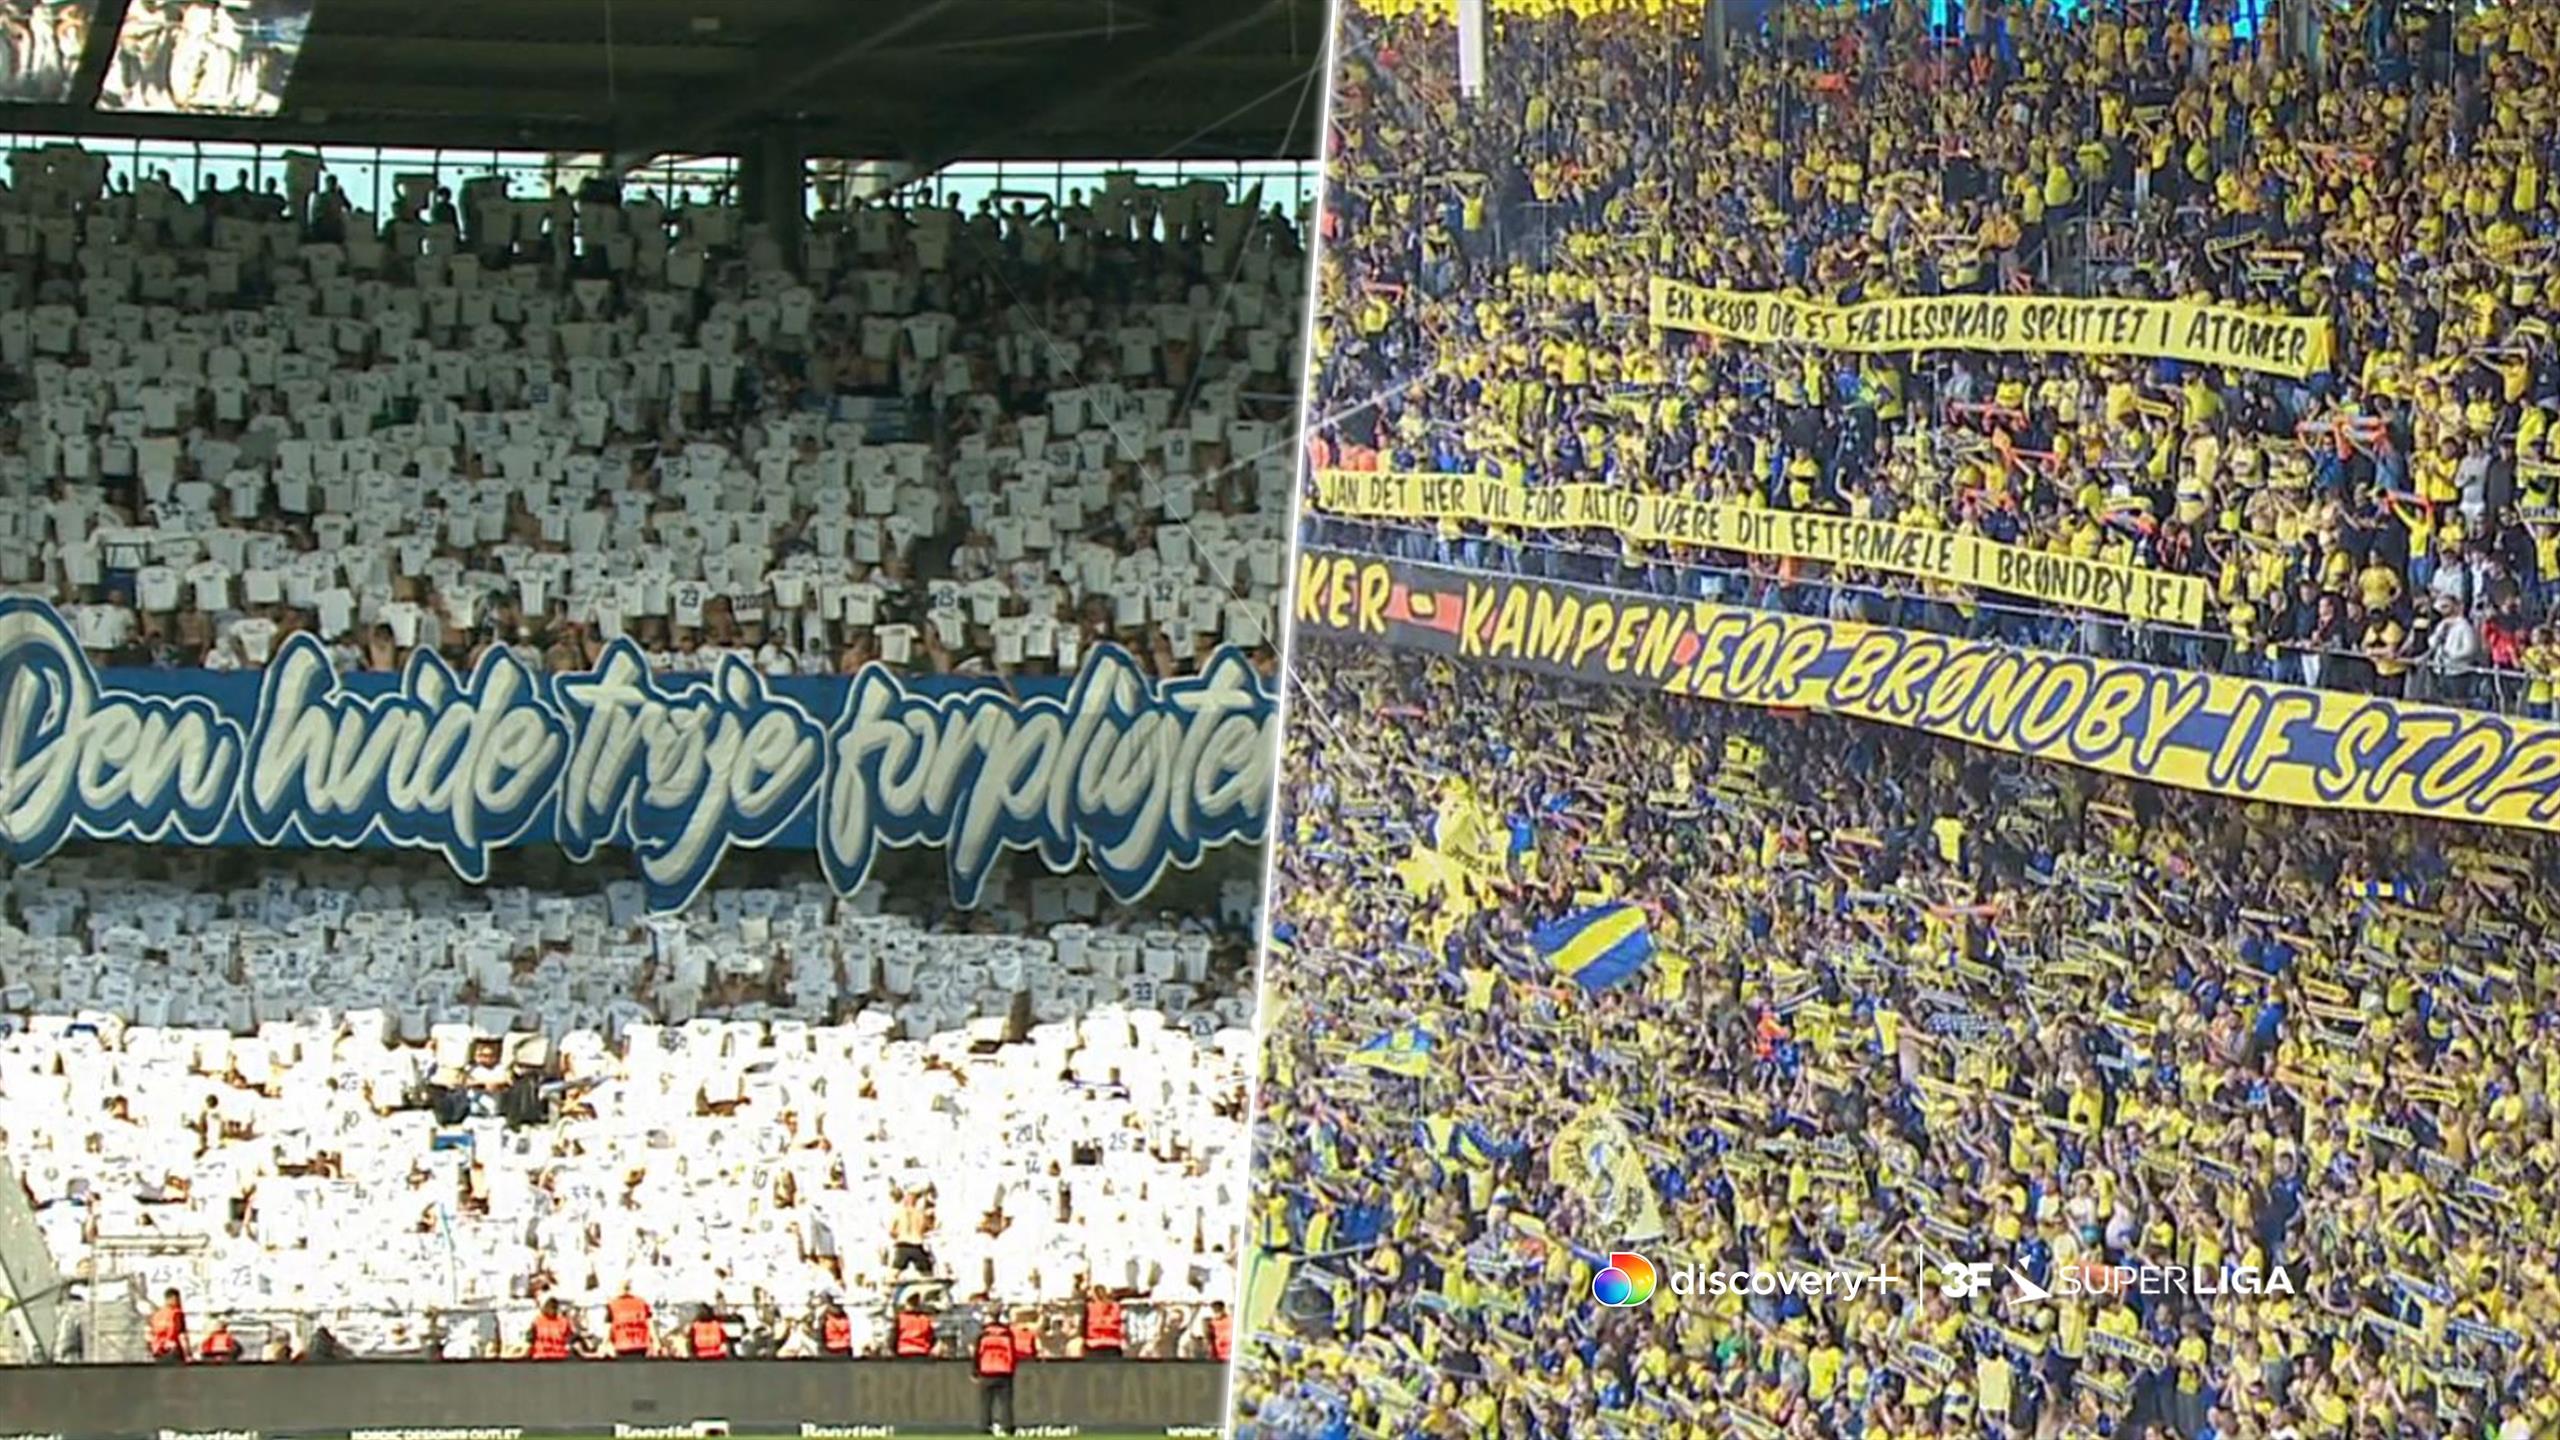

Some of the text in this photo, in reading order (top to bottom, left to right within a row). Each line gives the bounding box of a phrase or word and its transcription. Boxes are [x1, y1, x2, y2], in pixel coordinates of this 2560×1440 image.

[1845, 302, 2008, 345] FÆLLESSKAB
[2021, 305, 2148, 346] SPLITTET
[2160, 310, 2170, 347] I
[2185, 311, 2308, 366] ATOMER
[680, 588, 699, 607] 23
[1329, 478, 2190, 621] JAN DET HER VIL FOR ALTID VÆRE DIT EFTERMÆLE I BRØNDBY IF!
[1298, 552, 1391, 635] KER
[1460, 581, 1688, 679] KAMPEN
[1692, 615, 1829, 699] FOR
[1831, 631, 2205, 771] BRØNDBY
[2211, 690, 2316, 788] IF
[0, 610, 234, 843] Den
[252, 645, 563, 850] hvide
[560, 650, 817, 885] trøje
[857, 1368, 1064, 1422] BRØNBY
